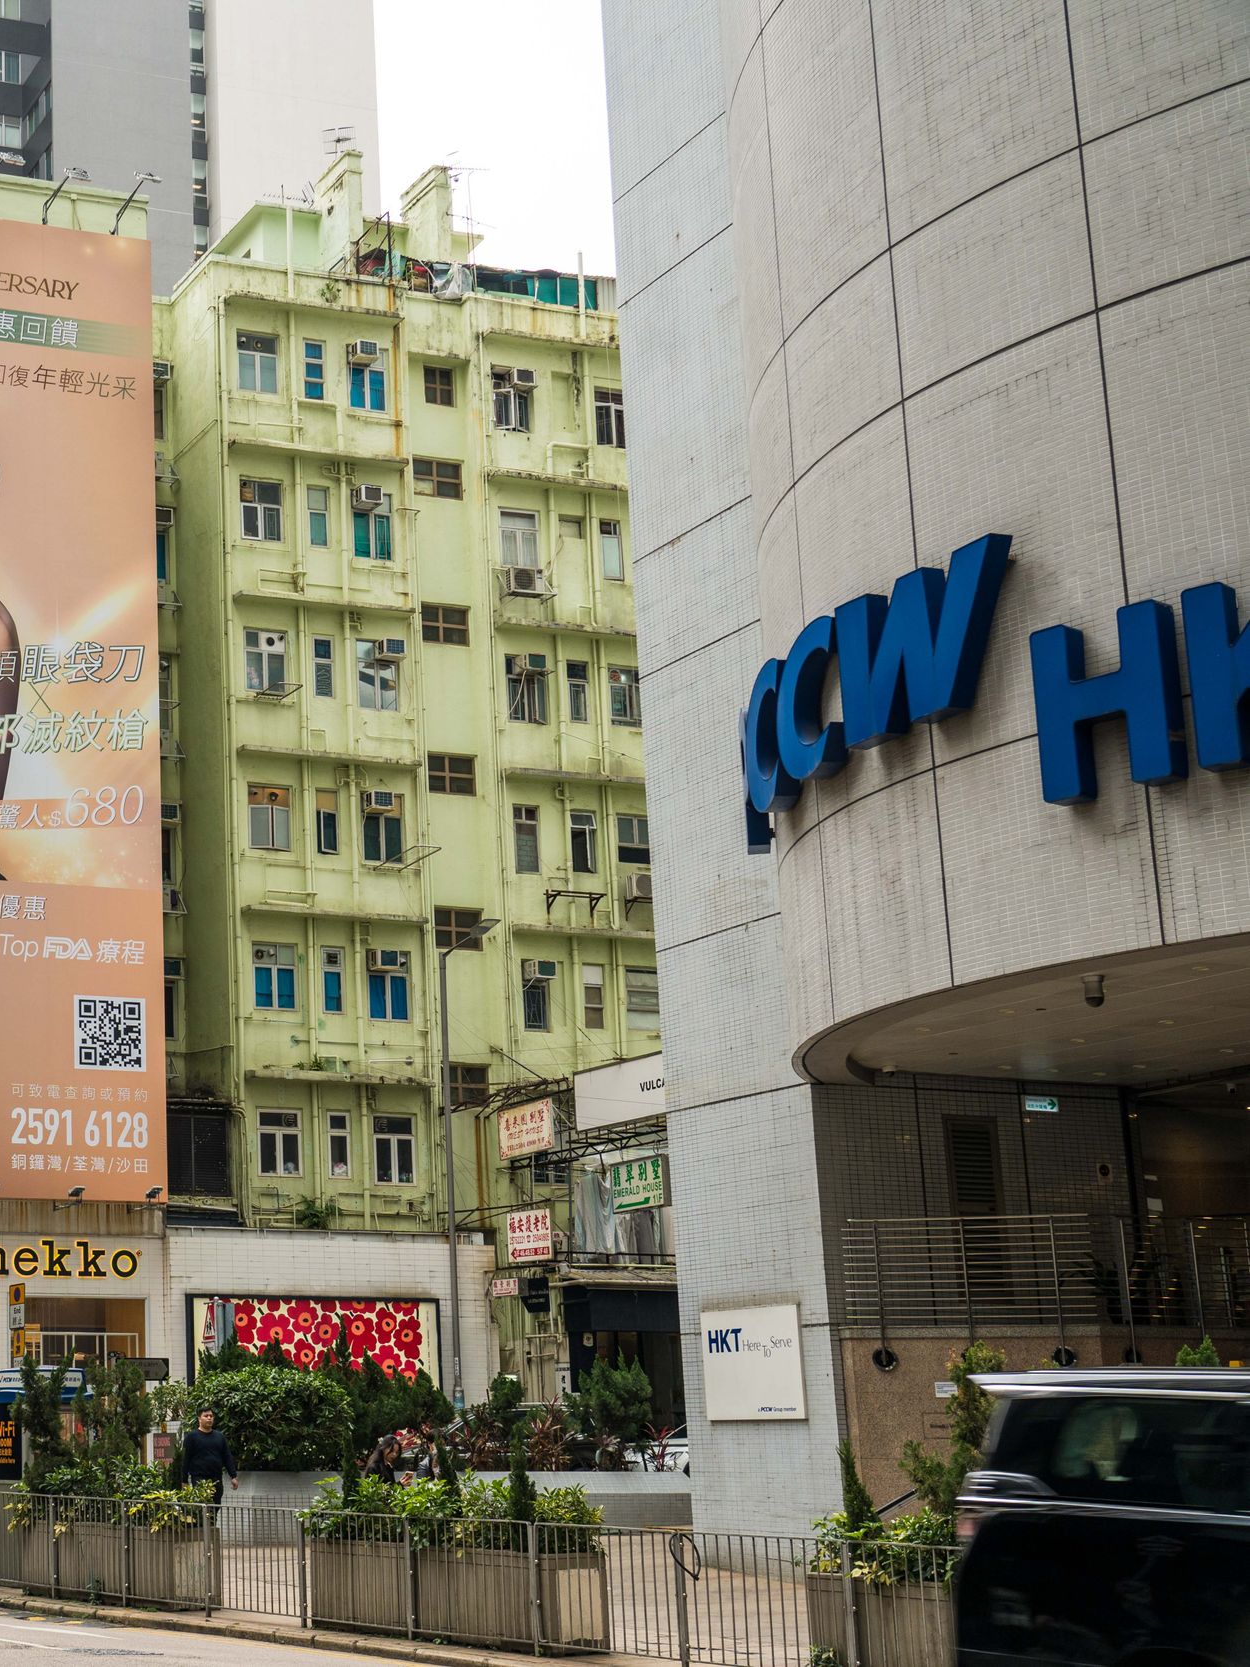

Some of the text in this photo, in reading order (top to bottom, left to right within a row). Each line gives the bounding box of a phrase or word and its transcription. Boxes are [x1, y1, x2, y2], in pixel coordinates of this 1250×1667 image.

[11, 1083, 148, 1103] 可致電查詢或預約
[10, 1107, 148, 1150] 2591 6128
[11, 1154, 148, 1174] 銅鑼灣/荃灣/沙田
[614, 1181, 662, 1199] EMERALD HOUSE
[707, 1328, 792, 1358] HKT Here To Serve
